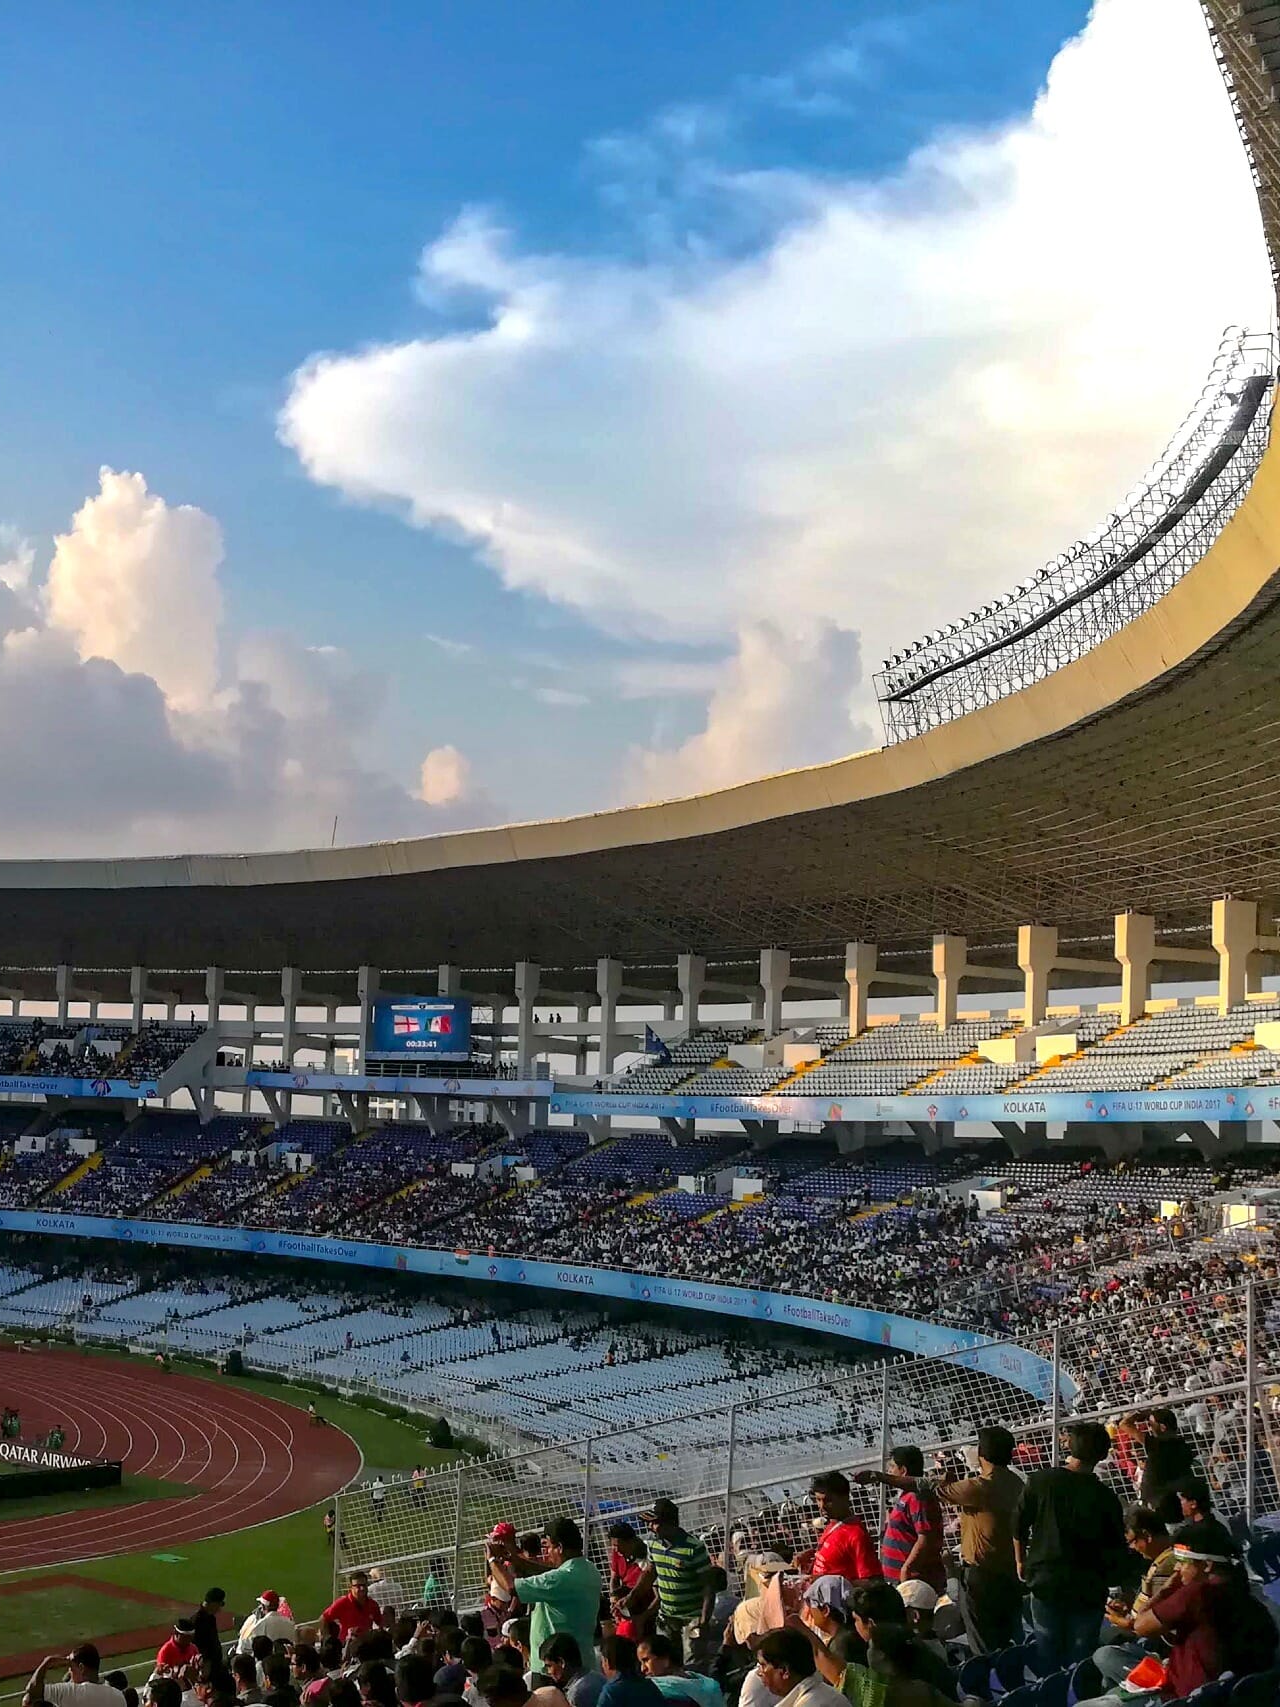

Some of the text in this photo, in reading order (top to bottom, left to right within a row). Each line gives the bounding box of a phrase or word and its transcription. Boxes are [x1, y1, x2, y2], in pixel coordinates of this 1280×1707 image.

[1003, 1102, 1046, 1113] KOLKATA
[1112, 1102, 1126, 1111] FIFA
[1144, 1101, 1168, 1110] WORLD
[1169, 1101, 1183, 1110] CUP
[1184, 1100, 1202, 1110] INDIA
[1205, 1099, 1221, 1109] 2017
[36, 1218, 76, 1229] KOLKATA
[557, 1271, 594, 1285] KOLKATA
[0, 1443, 38, 1463] QATAR
